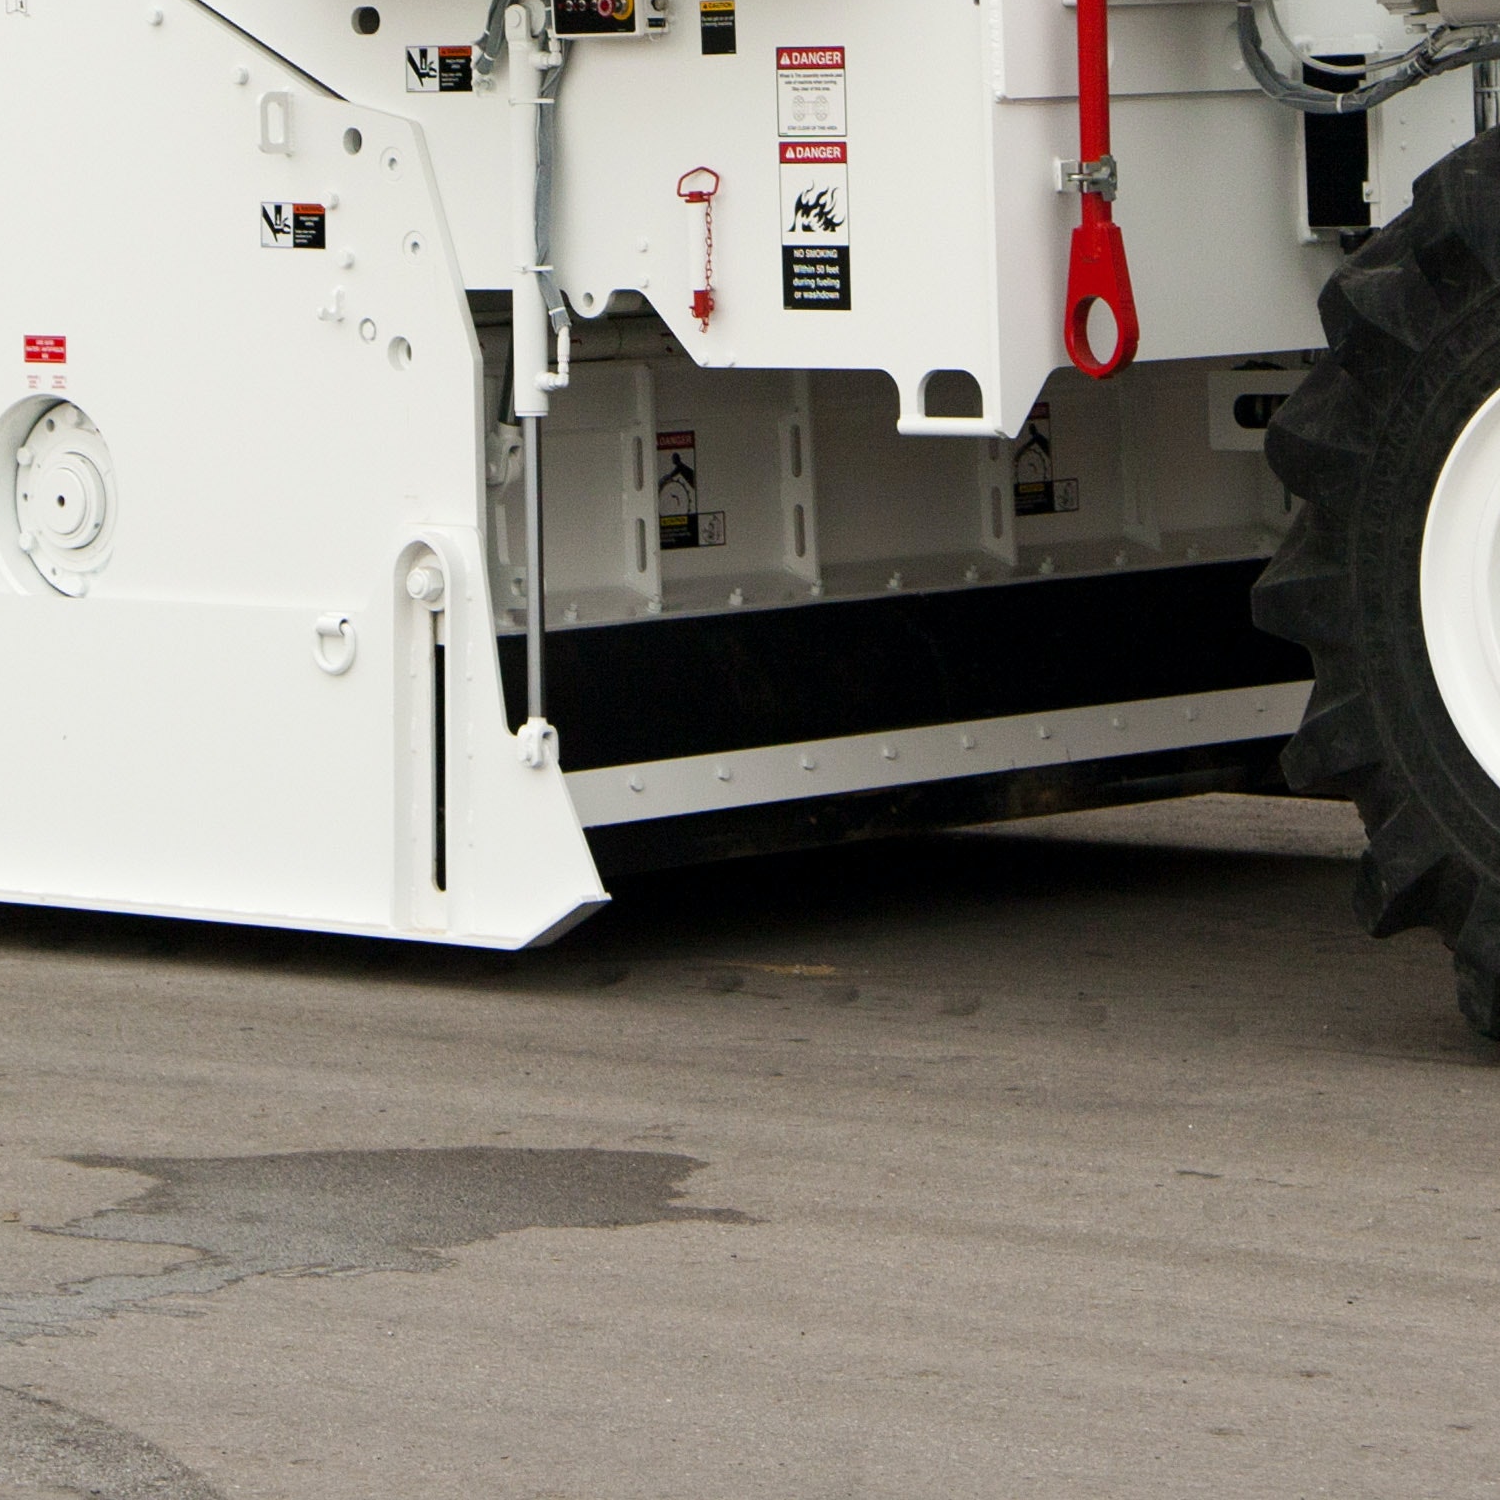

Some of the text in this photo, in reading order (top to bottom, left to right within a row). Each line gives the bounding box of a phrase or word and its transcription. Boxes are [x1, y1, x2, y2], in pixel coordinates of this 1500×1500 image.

[791, 51, 842, 65] DANGER
[796, 146, 841, 158] DANGER
[793, 249, 838, 258] NO SMOKING
[816, 264, 825, 274] 50
